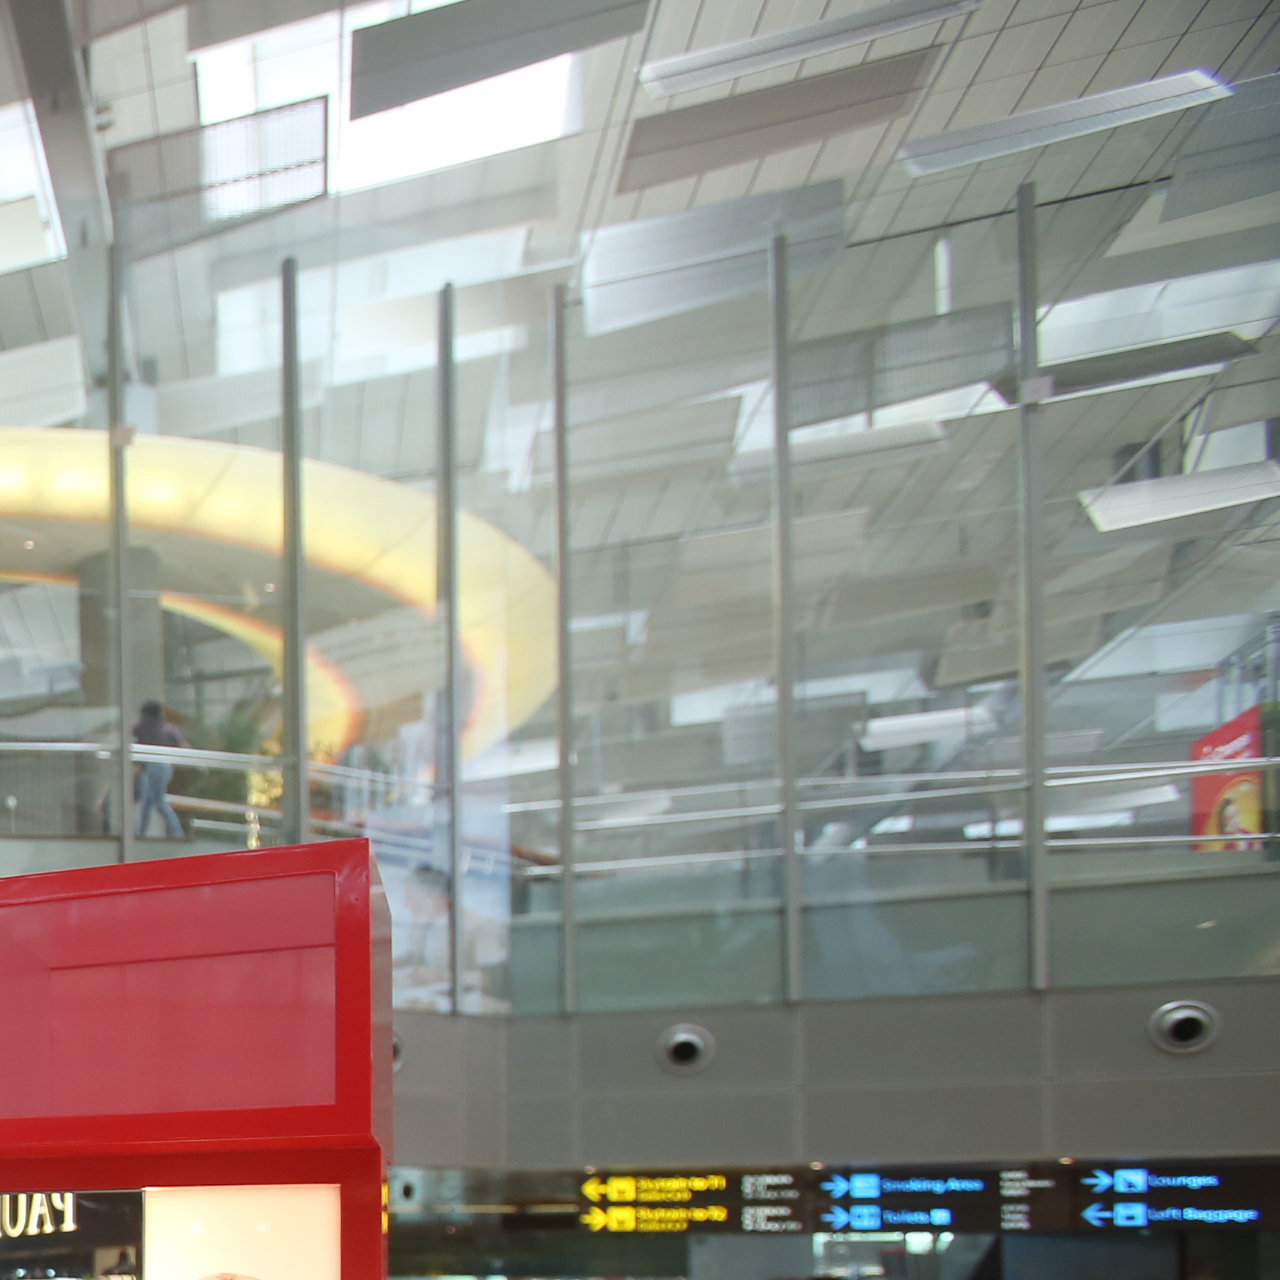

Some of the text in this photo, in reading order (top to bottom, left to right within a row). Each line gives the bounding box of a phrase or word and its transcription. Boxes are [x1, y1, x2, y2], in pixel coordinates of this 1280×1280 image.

[1148, 1174, 1221, 1189] Lounges
[1148, 1207, 1261, 1224] Left Baggage
